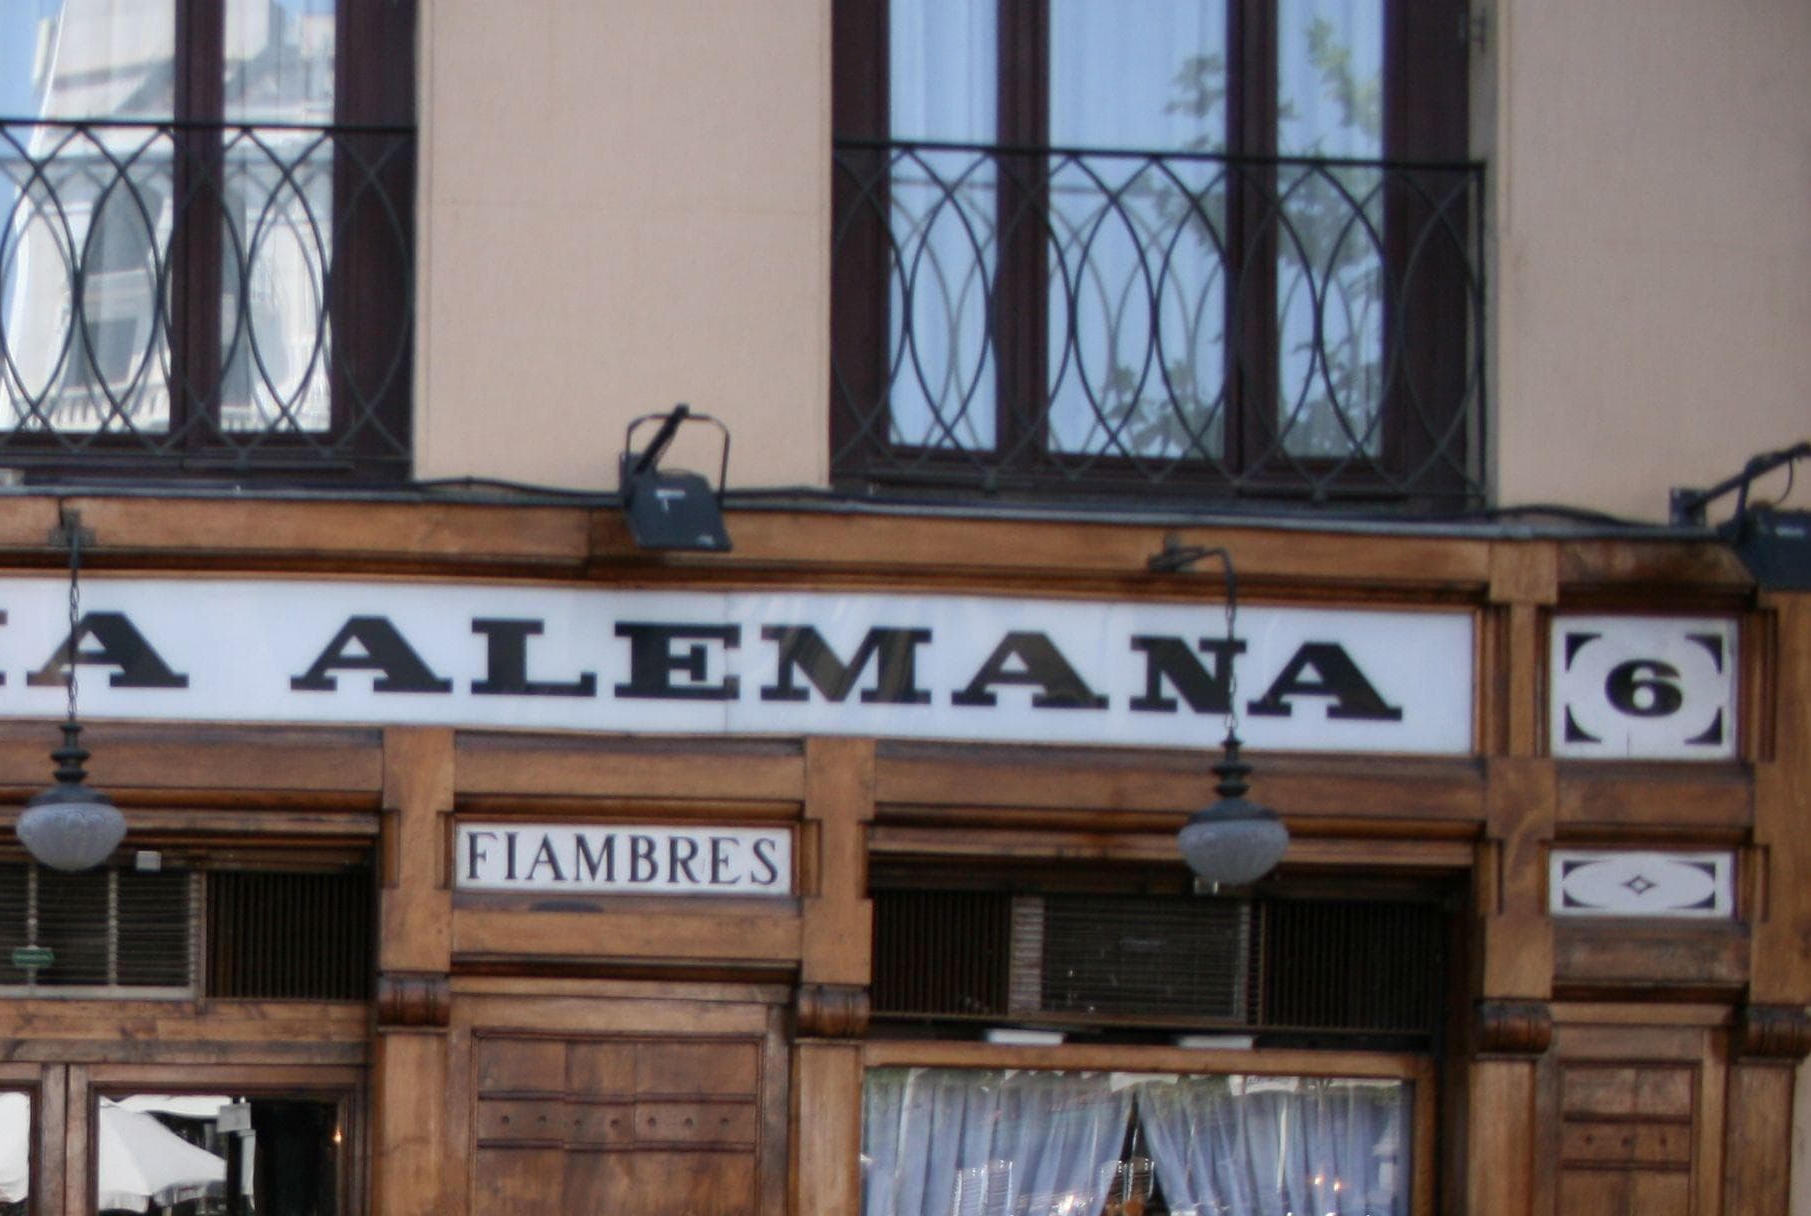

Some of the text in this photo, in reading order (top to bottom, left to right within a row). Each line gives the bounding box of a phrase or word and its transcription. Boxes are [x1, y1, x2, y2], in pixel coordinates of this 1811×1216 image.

[290, 616, 1404, 722] ALEMANA
[1605, 659, 1683, 717] 6
[466, 832, 780, 885] FIAMBRES
